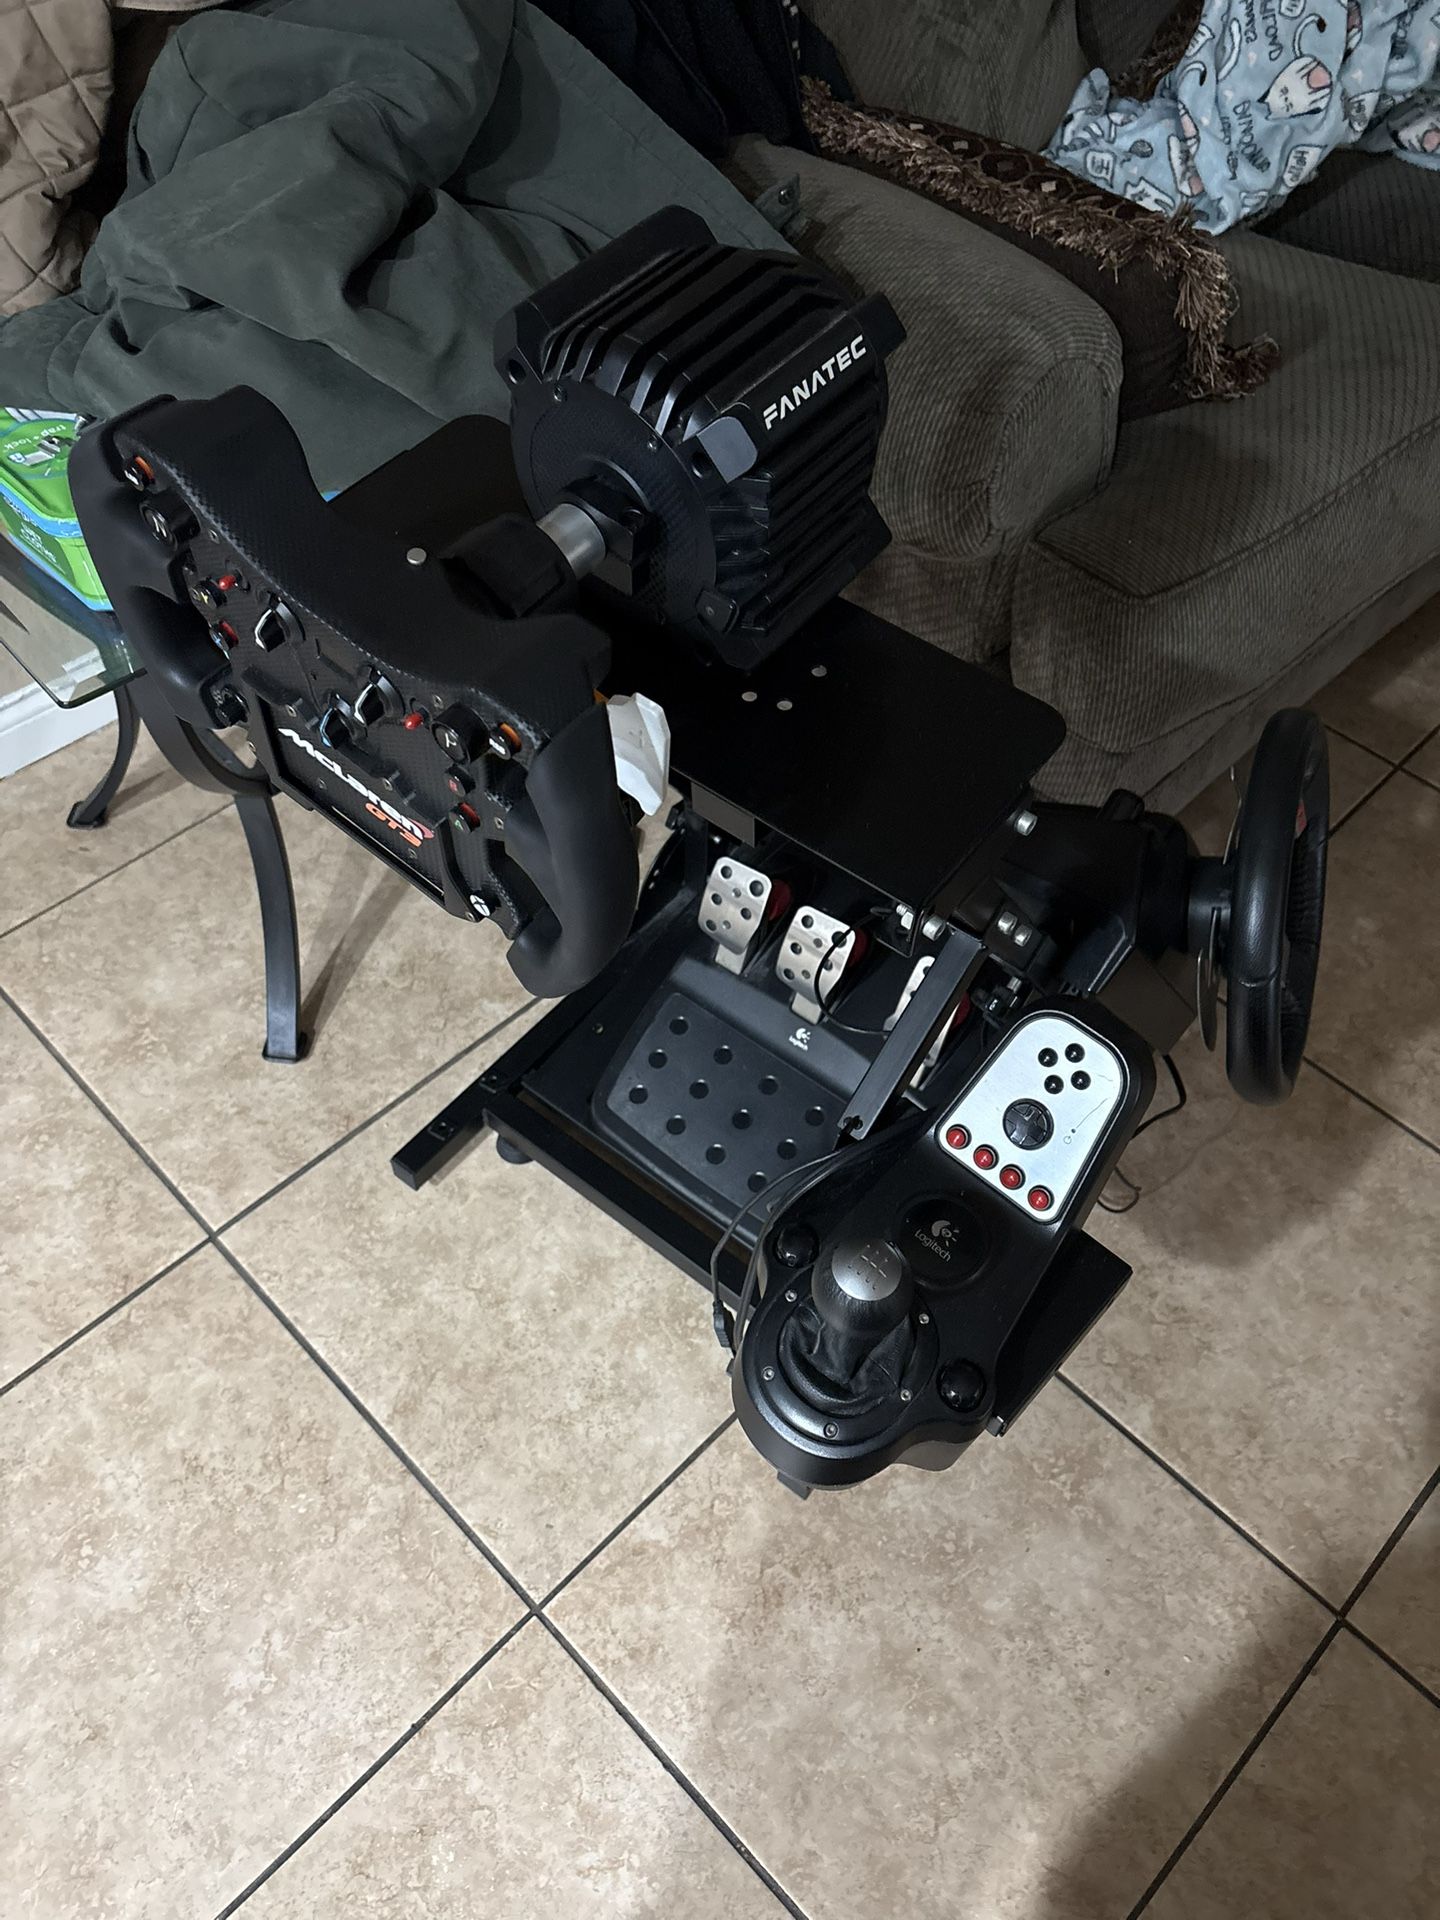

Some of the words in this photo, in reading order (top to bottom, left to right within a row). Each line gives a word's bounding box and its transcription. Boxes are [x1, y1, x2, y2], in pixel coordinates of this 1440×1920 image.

[763, 334, 867, 431] FANATEC
[277, 728, 424, 840] McLaren
[365, 802, 422, 848] GT3
[914, 1228, 952, 1262] Logitech
